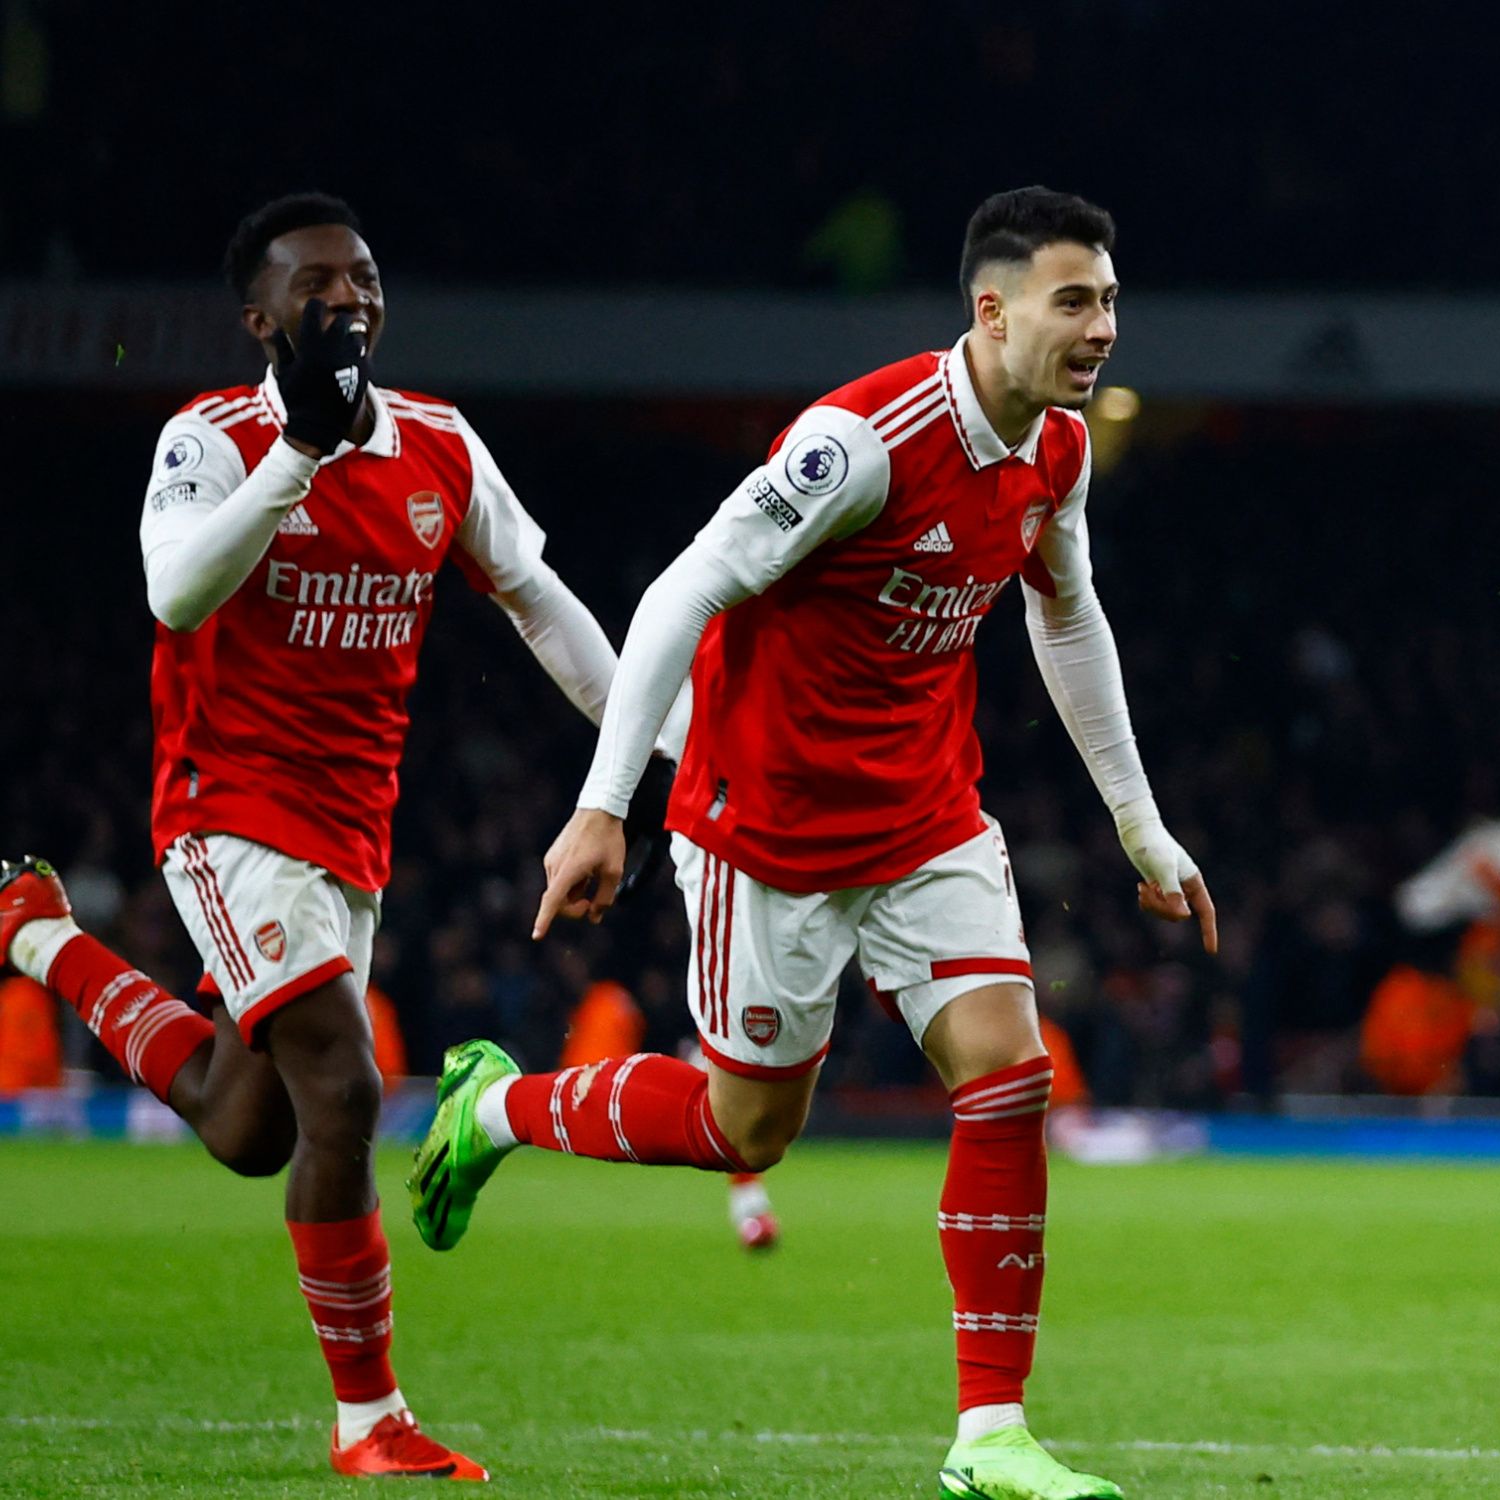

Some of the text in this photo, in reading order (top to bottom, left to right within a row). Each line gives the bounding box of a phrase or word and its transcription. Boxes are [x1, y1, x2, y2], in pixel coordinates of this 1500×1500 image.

[767, 491, 797, 521] room
[266, 558, 435, 606] Emirate
[288, 609, 336, 648] FLY
[885, 614, 983, 654] FLY BETT
[998, 1253, 1048, 1270] AF
